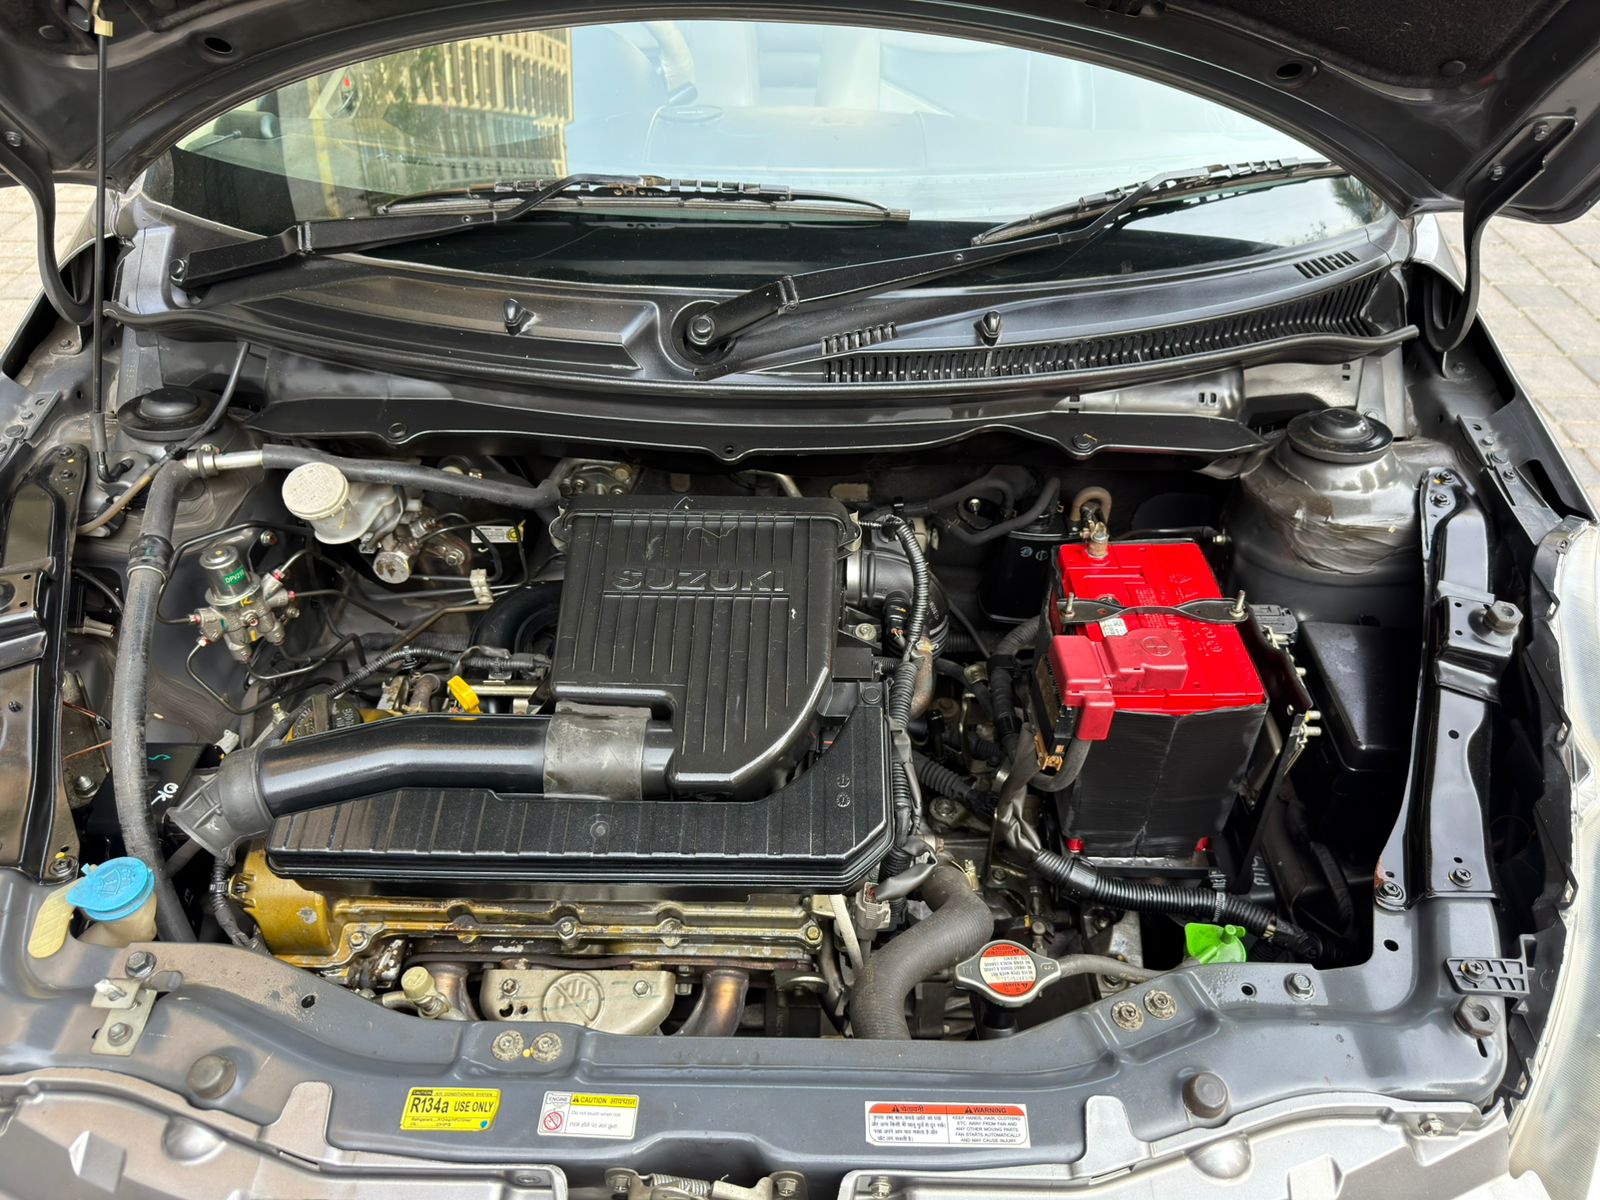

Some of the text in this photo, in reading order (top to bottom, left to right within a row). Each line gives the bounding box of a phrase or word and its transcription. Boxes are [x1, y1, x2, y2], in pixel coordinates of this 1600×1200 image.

[612, 569, 784, 591] SUZUKI
[410, 1097, 494, 1114] R134a USE ONLY
[580, 1096, 607, 1104] CAUTION
